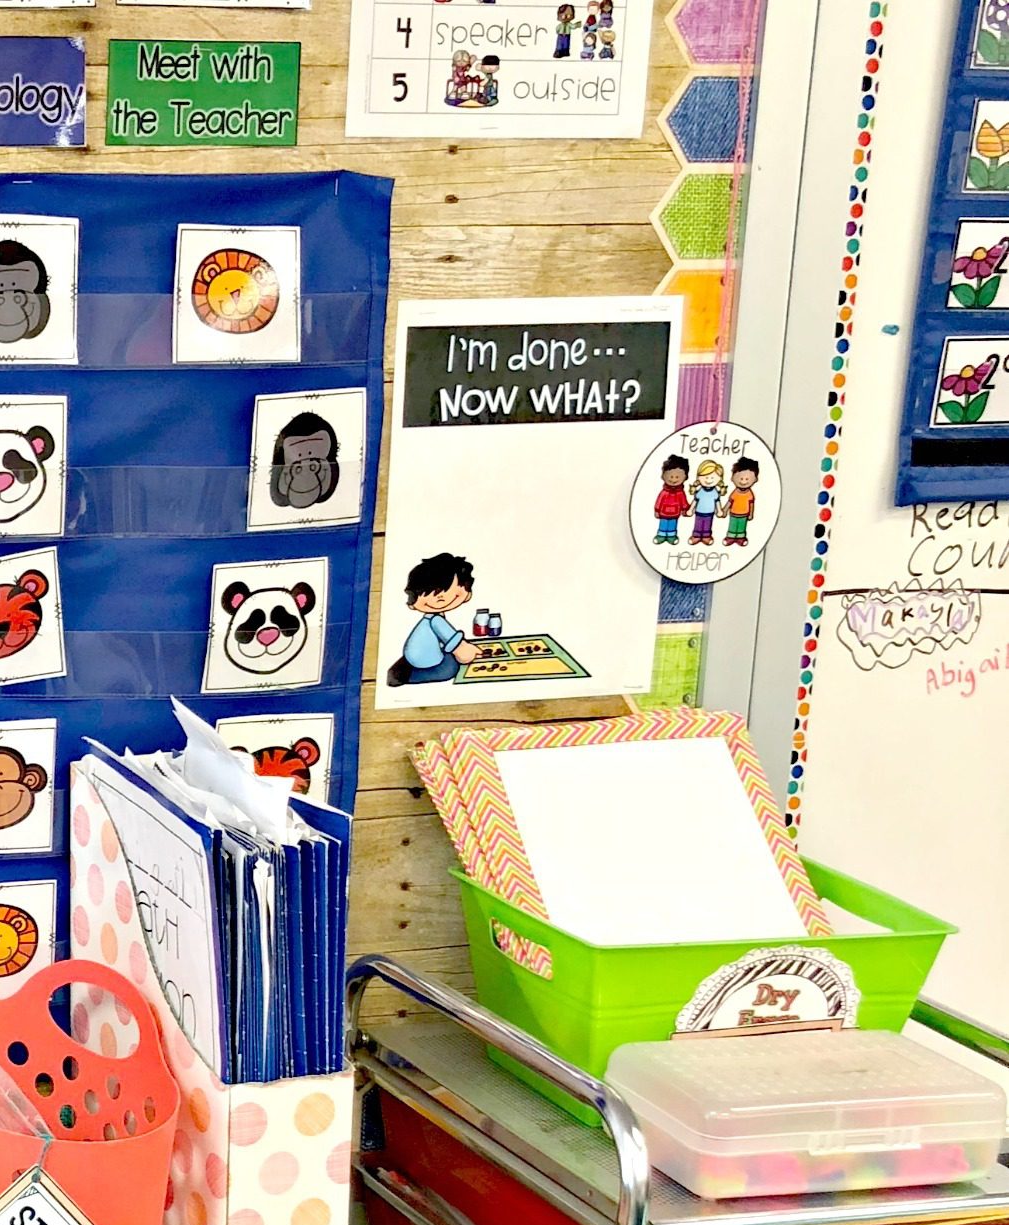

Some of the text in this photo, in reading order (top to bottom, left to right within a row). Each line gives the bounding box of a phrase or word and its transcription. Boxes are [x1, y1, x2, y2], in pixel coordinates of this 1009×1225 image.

[396, 17, 548, 52] 4 speaker
[138, 42, 273, 84] Meet with
[392, 72, 616, 102] 5 outside
[113, 100, 293, 137] the Teacher
[446, 334, 497, 373] I'm
[439, 385, 519, 422] NOW
[680, 433, 750, 457] Teacher
[850, 602, 968, 635] Makayla
[752, 983, 800, 1011] Dry
